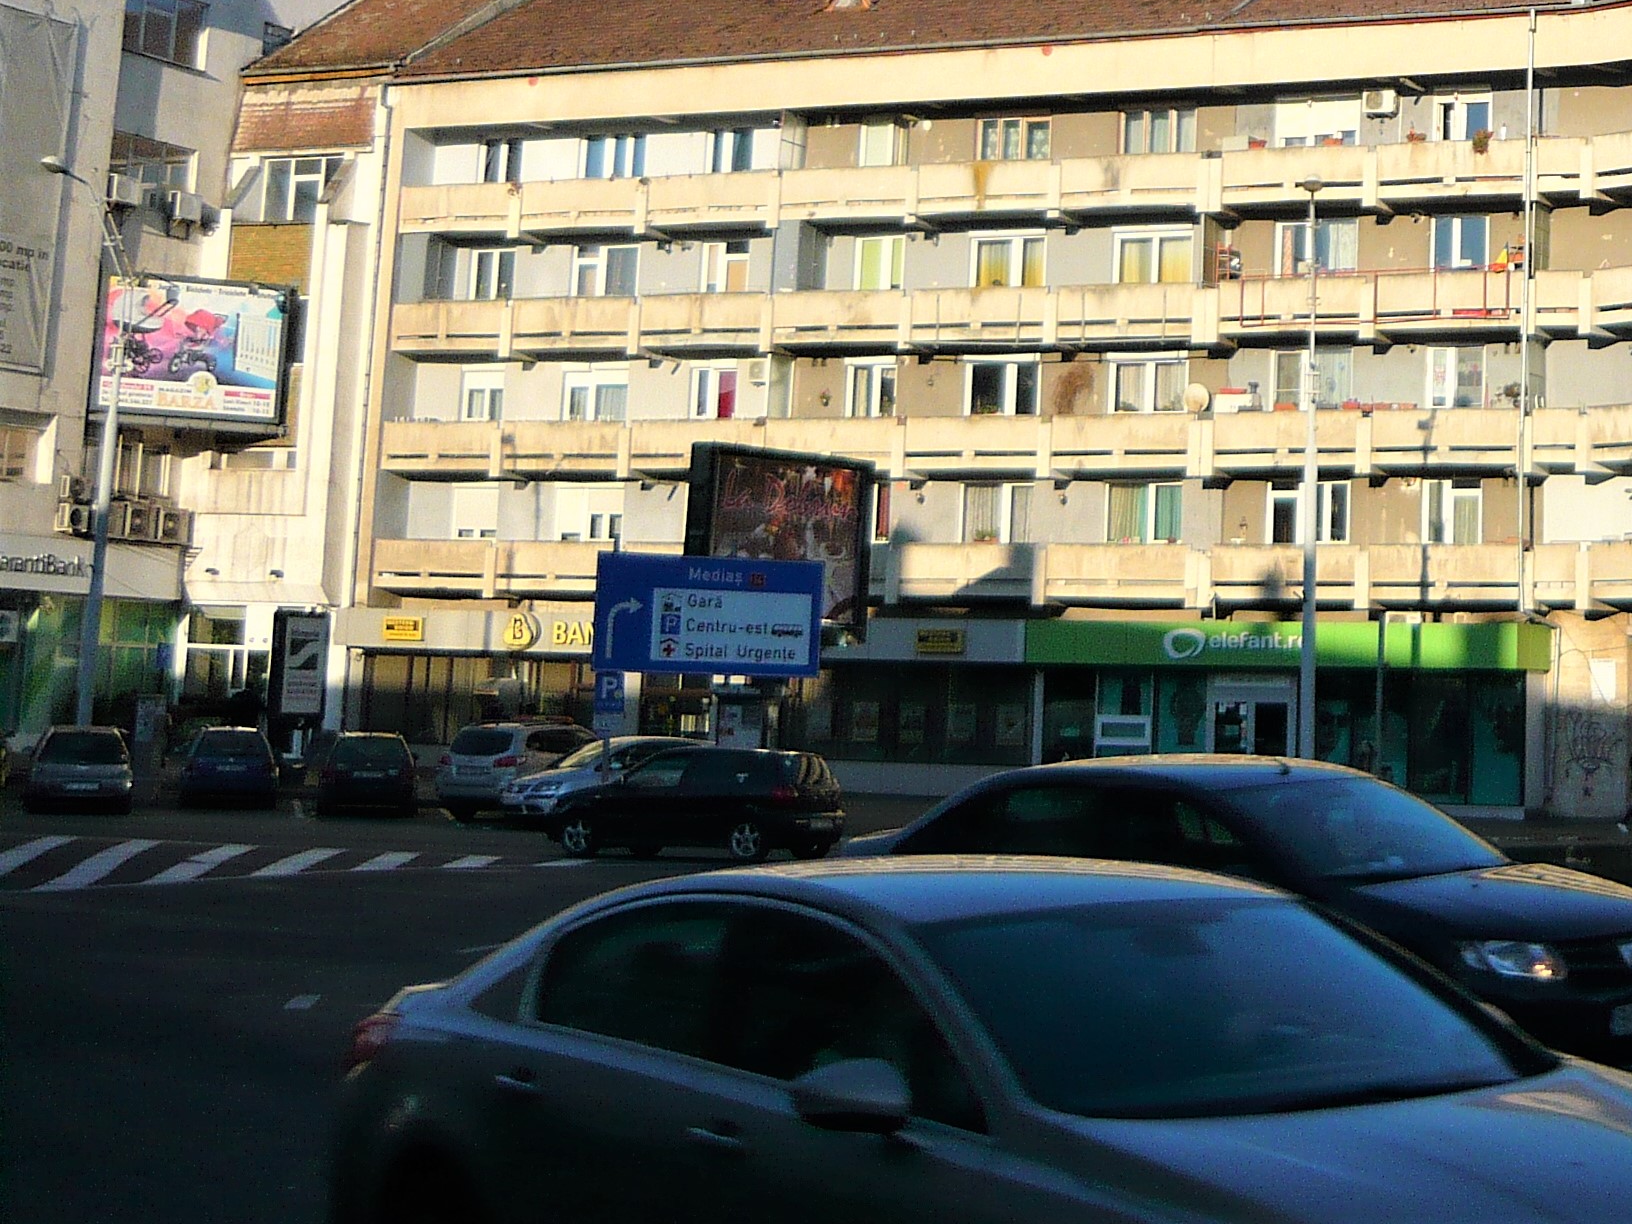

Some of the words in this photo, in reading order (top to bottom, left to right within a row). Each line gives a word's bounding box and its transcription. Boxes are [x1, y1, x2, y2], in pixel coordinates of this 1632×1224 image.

[156, 392, 217, 410] BARZA
[687, 593, 723, 609] Gară
[686, 618, 767, 635] Centru-est
[685, 642, 727, 660] Spital
